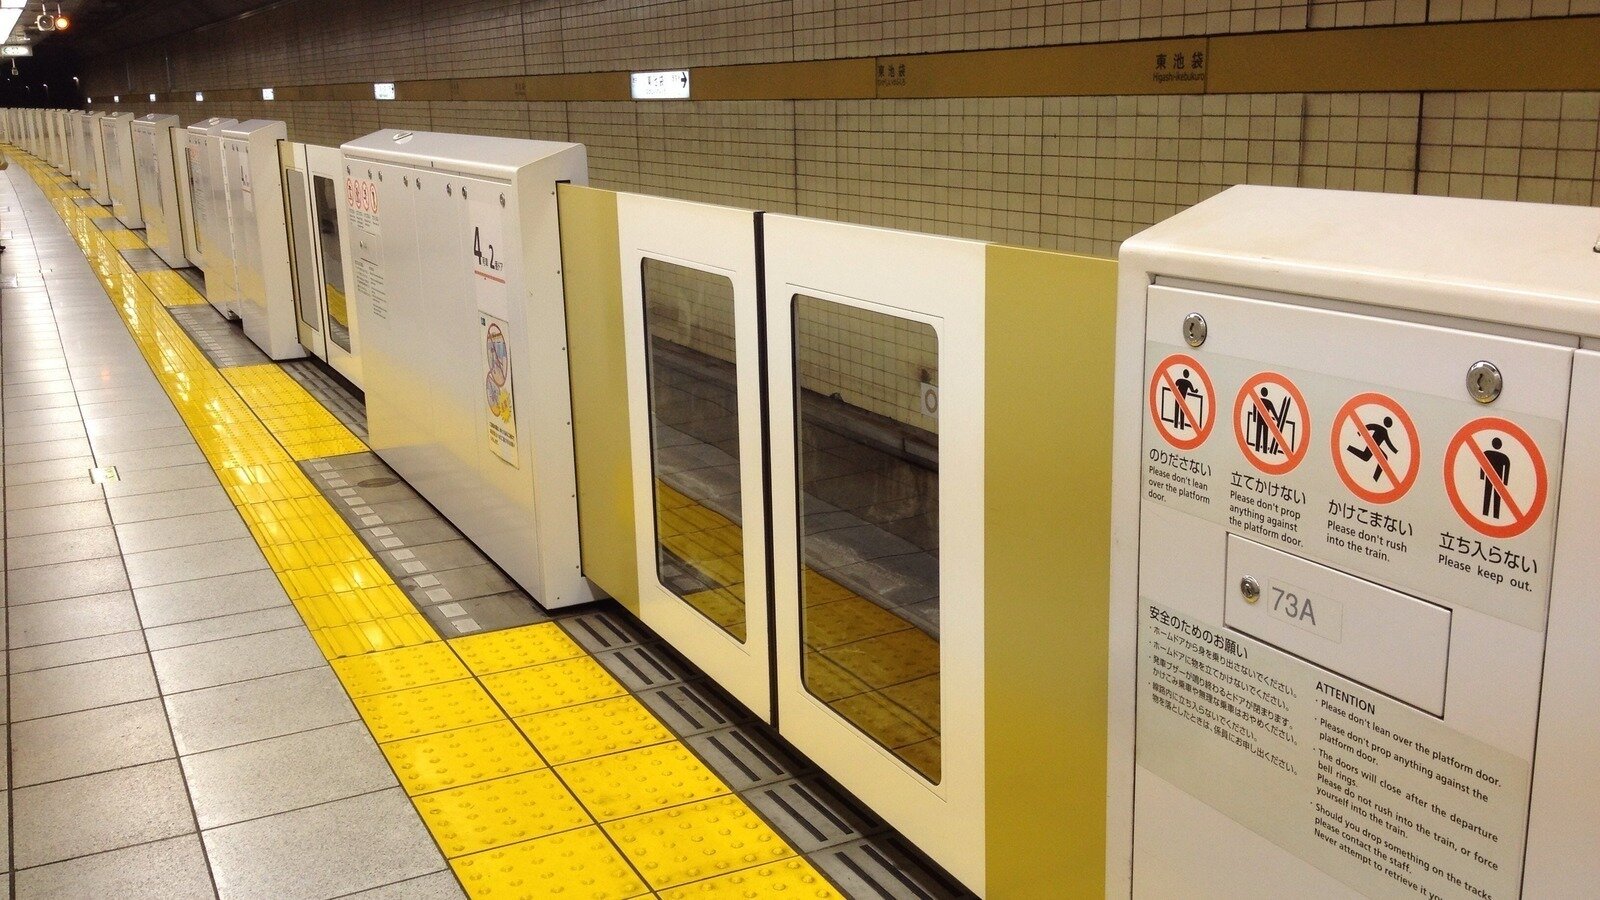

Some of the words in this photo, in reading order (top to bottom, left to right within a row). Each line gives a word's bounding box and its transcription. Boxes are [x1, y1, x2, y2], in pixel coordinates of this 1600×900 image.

[1155, 51, 1204, 70] 東池袋
[1148, 466, 1170, 478] Please
[1172, 472, 1191, 486] don't
[1193, 478, 1208, 491] lean
[1150, 448, 1211, 476] のりださない
[1148, 479, 1165, 490] over
[1166, 482, 1178, 494] the
[1179, 487, 1210, 504] platform
[1148, 490, 1166, 502] door.
[1230, 472, 1306, 504] 立てかけない
[1230, 490, 1254, 506] Please
[1257, 498, 1279, 513] don't
[1281, 506, 1300, 520] prop
[1229, 516, 1242, 528] the
[1244, 520, 1279, 539] platform
[1281, 532, 1304, 547] door.
[1230, 504, 1265, 523] anything
[1267, 514, 1298, 532] against
[1328, 499, 1413, 536] かけこまない
[1326, 533, 1345, 548] into
[1347, 539, 1362, 553] the
[1365, 544, 1390, 562] train.
[1327, 520, 1356, 537] Please
[1358, 528, 1384, 546] don't
[1386, 538, 1408, 553] rush
[1439, 532, 1538, 574] 立ち入らない
[1438, 554, 1471, 573] Please
[1477, 565, 1504, 584] keep
[1510, 577, 1532, 592] out.
[1271, 586, 1316, 626] 73A
[1150, 606, 1248, 659] 安全のためのお願い
[1316, 681, 1375, 715] ATTENTION
[1319, 732, 1354, 754] platform
[1356, 748, 1378, 766] door.
[1320, 718, 1345, 736] Please
[1347, 727, 1369, 747] don't
[1371, 742, 1391, 758] prop
[1394, 751, 1434, 779] anything
[1436, 772, 1470, 795] against
[1472, 787, 1488, 803] the
[1321, 699, 1346, 718] Please
[1348, 709, 1370, 729] don't
[1372, 722, 1390, 738] lean
[1392, 732, 1413, 747] over
[1415, 742, 1430, 755] the
[1432, 750, 1473, 775] platform
[1475, 770, 1501, 788] door.
[1318, 760, 1333, 774] bell
[1336, 770, 1358, 788] rings.
[1316, 786, 1349, 808] yourself
[1350, 802, 1368, 818] into
[1369, 812, 1383, 826] the
[1385, 820, 1408, 838] train.
[1319, 748, 1333, 762] The
[1336, 756, 1358, 774] doors
[1361, 770, 1377, 784] will
[1380, 780, 1401, 796] close
[1405, 793, 1428, 808] after
[1431, 803, 1447, 818] the
[1450, 813, 1498, 843] departure
[1317, 773, 1342, 792] Please
[1344, 788, 1355, 798] do
[1358, 795, 1372, 808] not
[1375, 804, 1393, 817] rush
[1395, 812, 1413, 828] into
[1416, 823, 1431, 837] the
[1433, 832, 1458, 852] train,
[1460, 846, 1471, 856] or
[1473, 852, 1499, 871] force
[1315, 816, 1340, 834] please
[1342, 832, 1372, 852] contact
[1373, 847, 1388, 860] the
[1389, 856, 1412, 874] staff.
[1316, 803, 1342, 823] Should
[1345, 819, 1360, 833] you
[1362, 828, 1382, 845] drop
[1384, 839, 1430, 871] something
[1432, 865, 1444, 877] on
[1446, 872, 1462, 886] the
[1314, 828, 1337, 846] Never
[1339, 842, 1372, 866] attempt
[1374, 860, 1383, 871] to
[1384, 868, 1418, 890] retrieve
[1420, 885, 1428, 896] it
